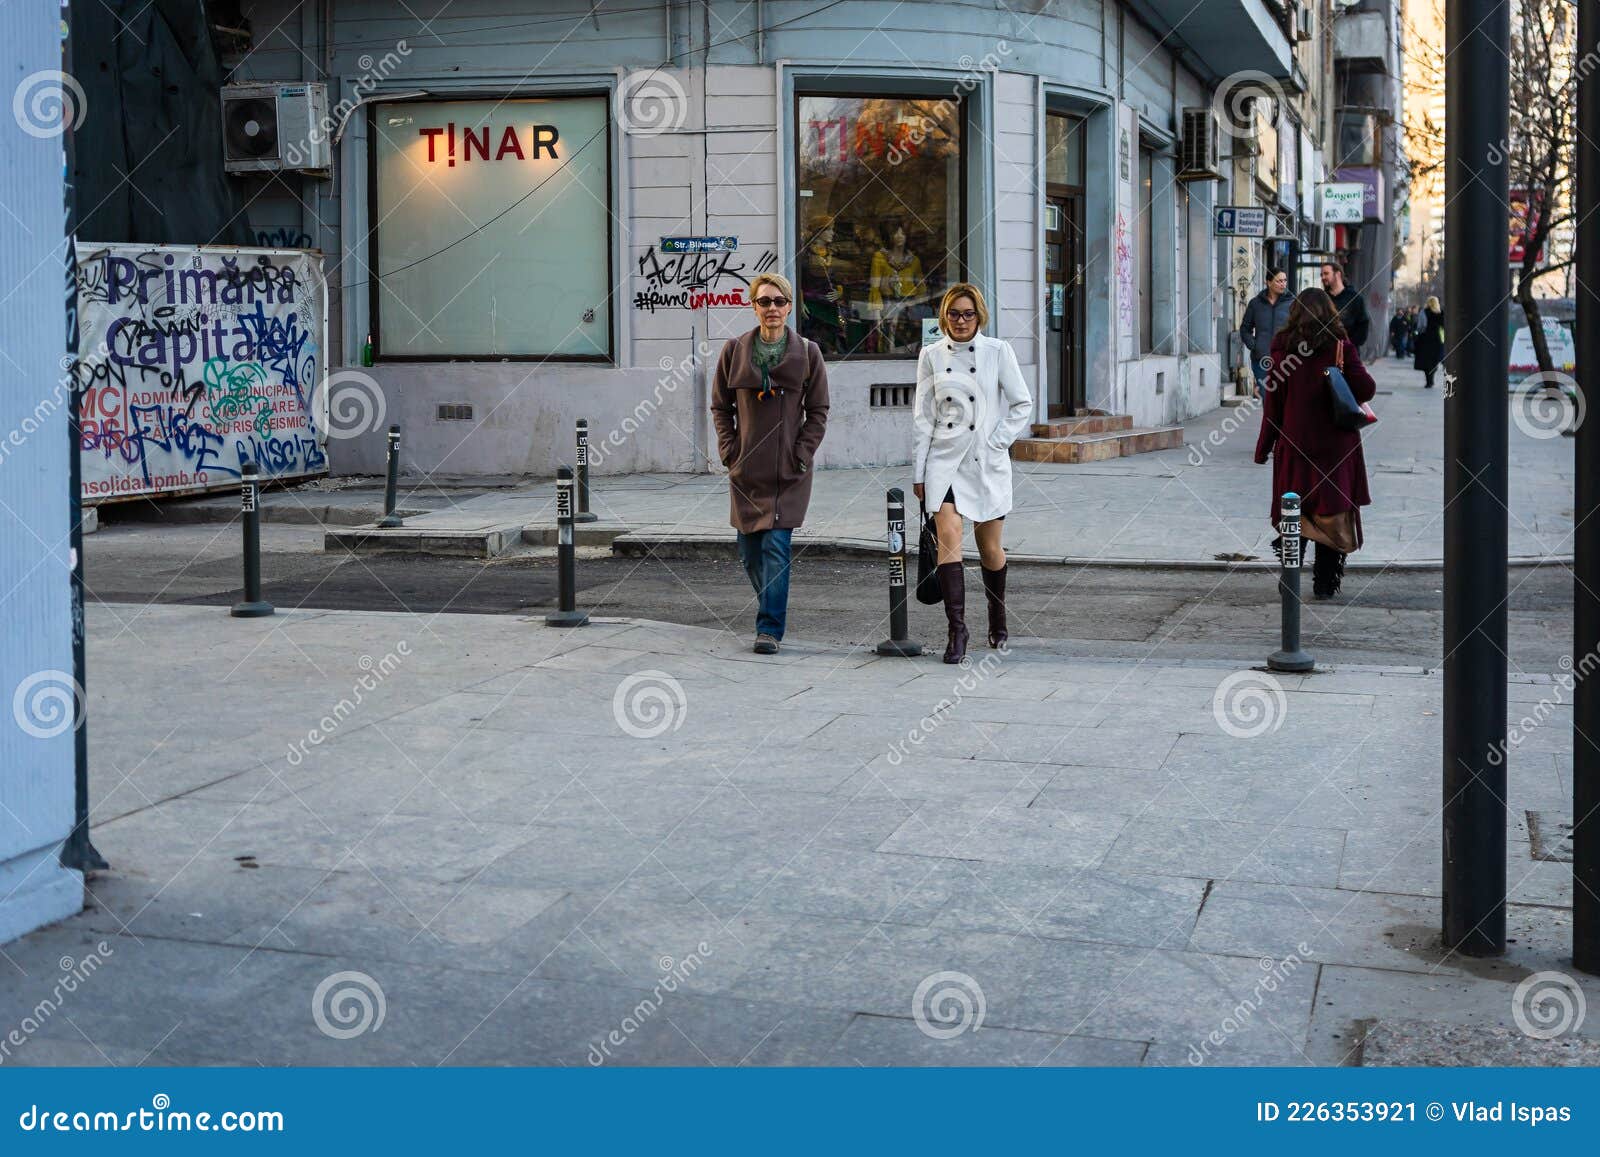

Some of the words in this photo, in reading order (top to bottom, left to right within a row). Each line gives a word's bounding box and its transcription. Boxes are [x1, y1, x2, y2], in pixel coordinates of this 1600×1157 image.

[674, 241, 688, 249] Str.
[263, 415, 306, 431] SEISMIC
[558, 491, 569, 516] BNE
[1285, 540, 1298, 566] BNE
[890, 560, 902, 584] BNE
